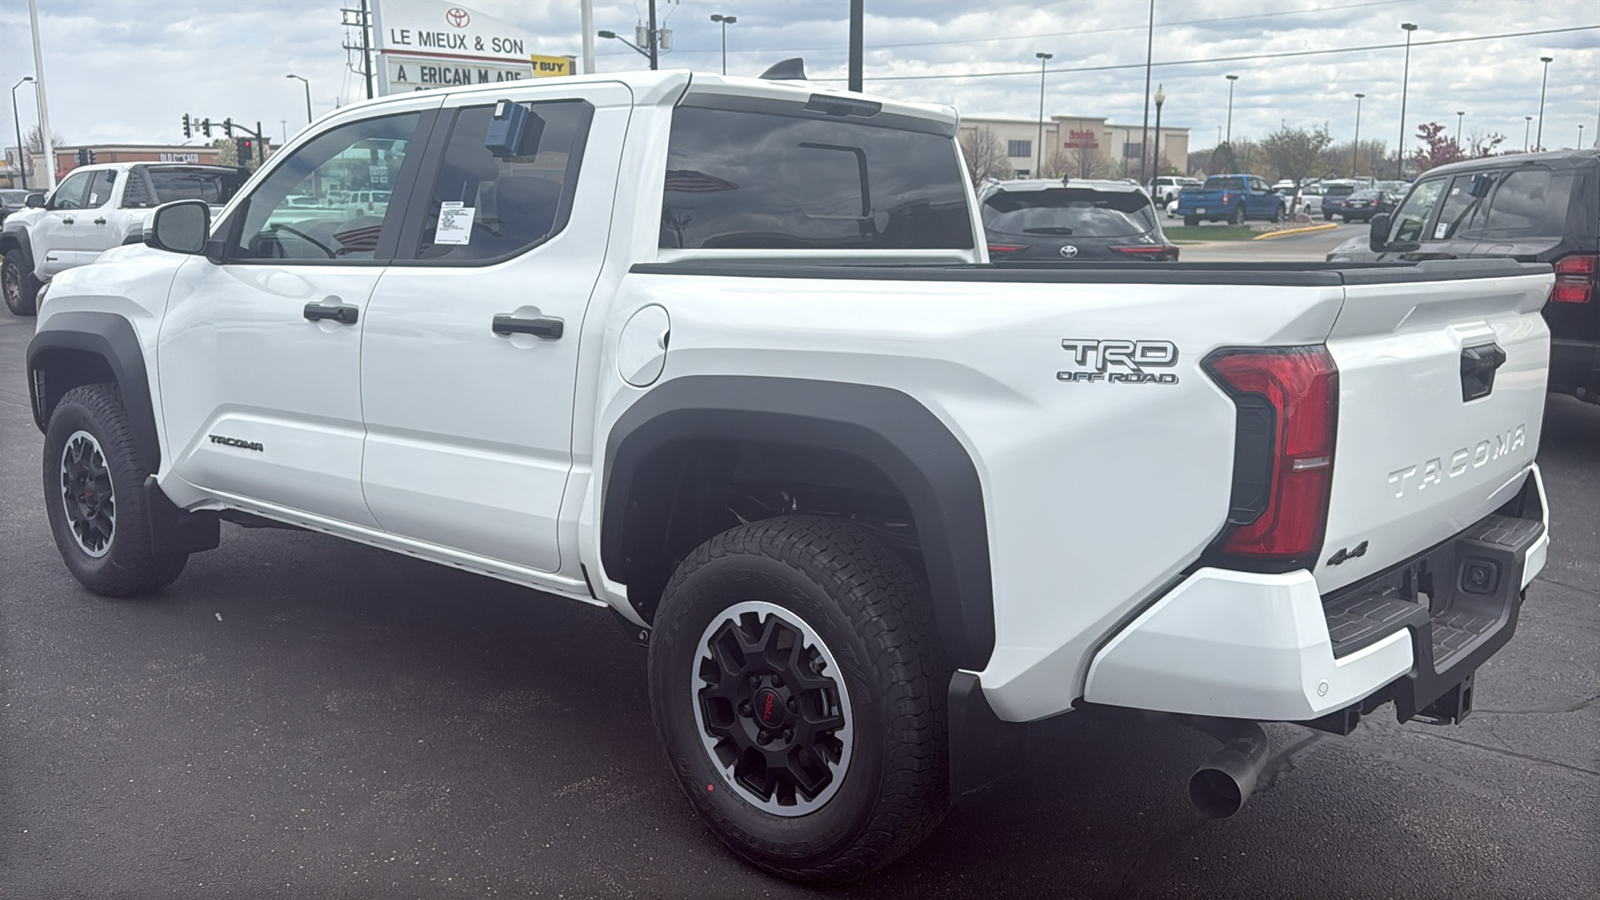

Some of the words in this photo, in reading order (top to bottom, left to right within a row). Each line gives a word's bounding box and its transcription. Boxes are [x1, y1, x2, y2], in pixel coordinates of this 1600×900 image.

[391, 28, 411, 45] LE
[418, 31, 467, 50] MIEUX
[474, 36, 485, 51] &
[492, 37, 524, 55] SON
[540, 62, 564, 72] BUY
[1062, 339, 1179, 374] TRD
[1056, 371, 1104, 382] OFF
[1108, 372, 1179, 385] ROAD
[208, 434, 264, 452] TACOMA
[1388, 423, 1526, 499] TACOMA
[764, 693, 774, 720] TRD
